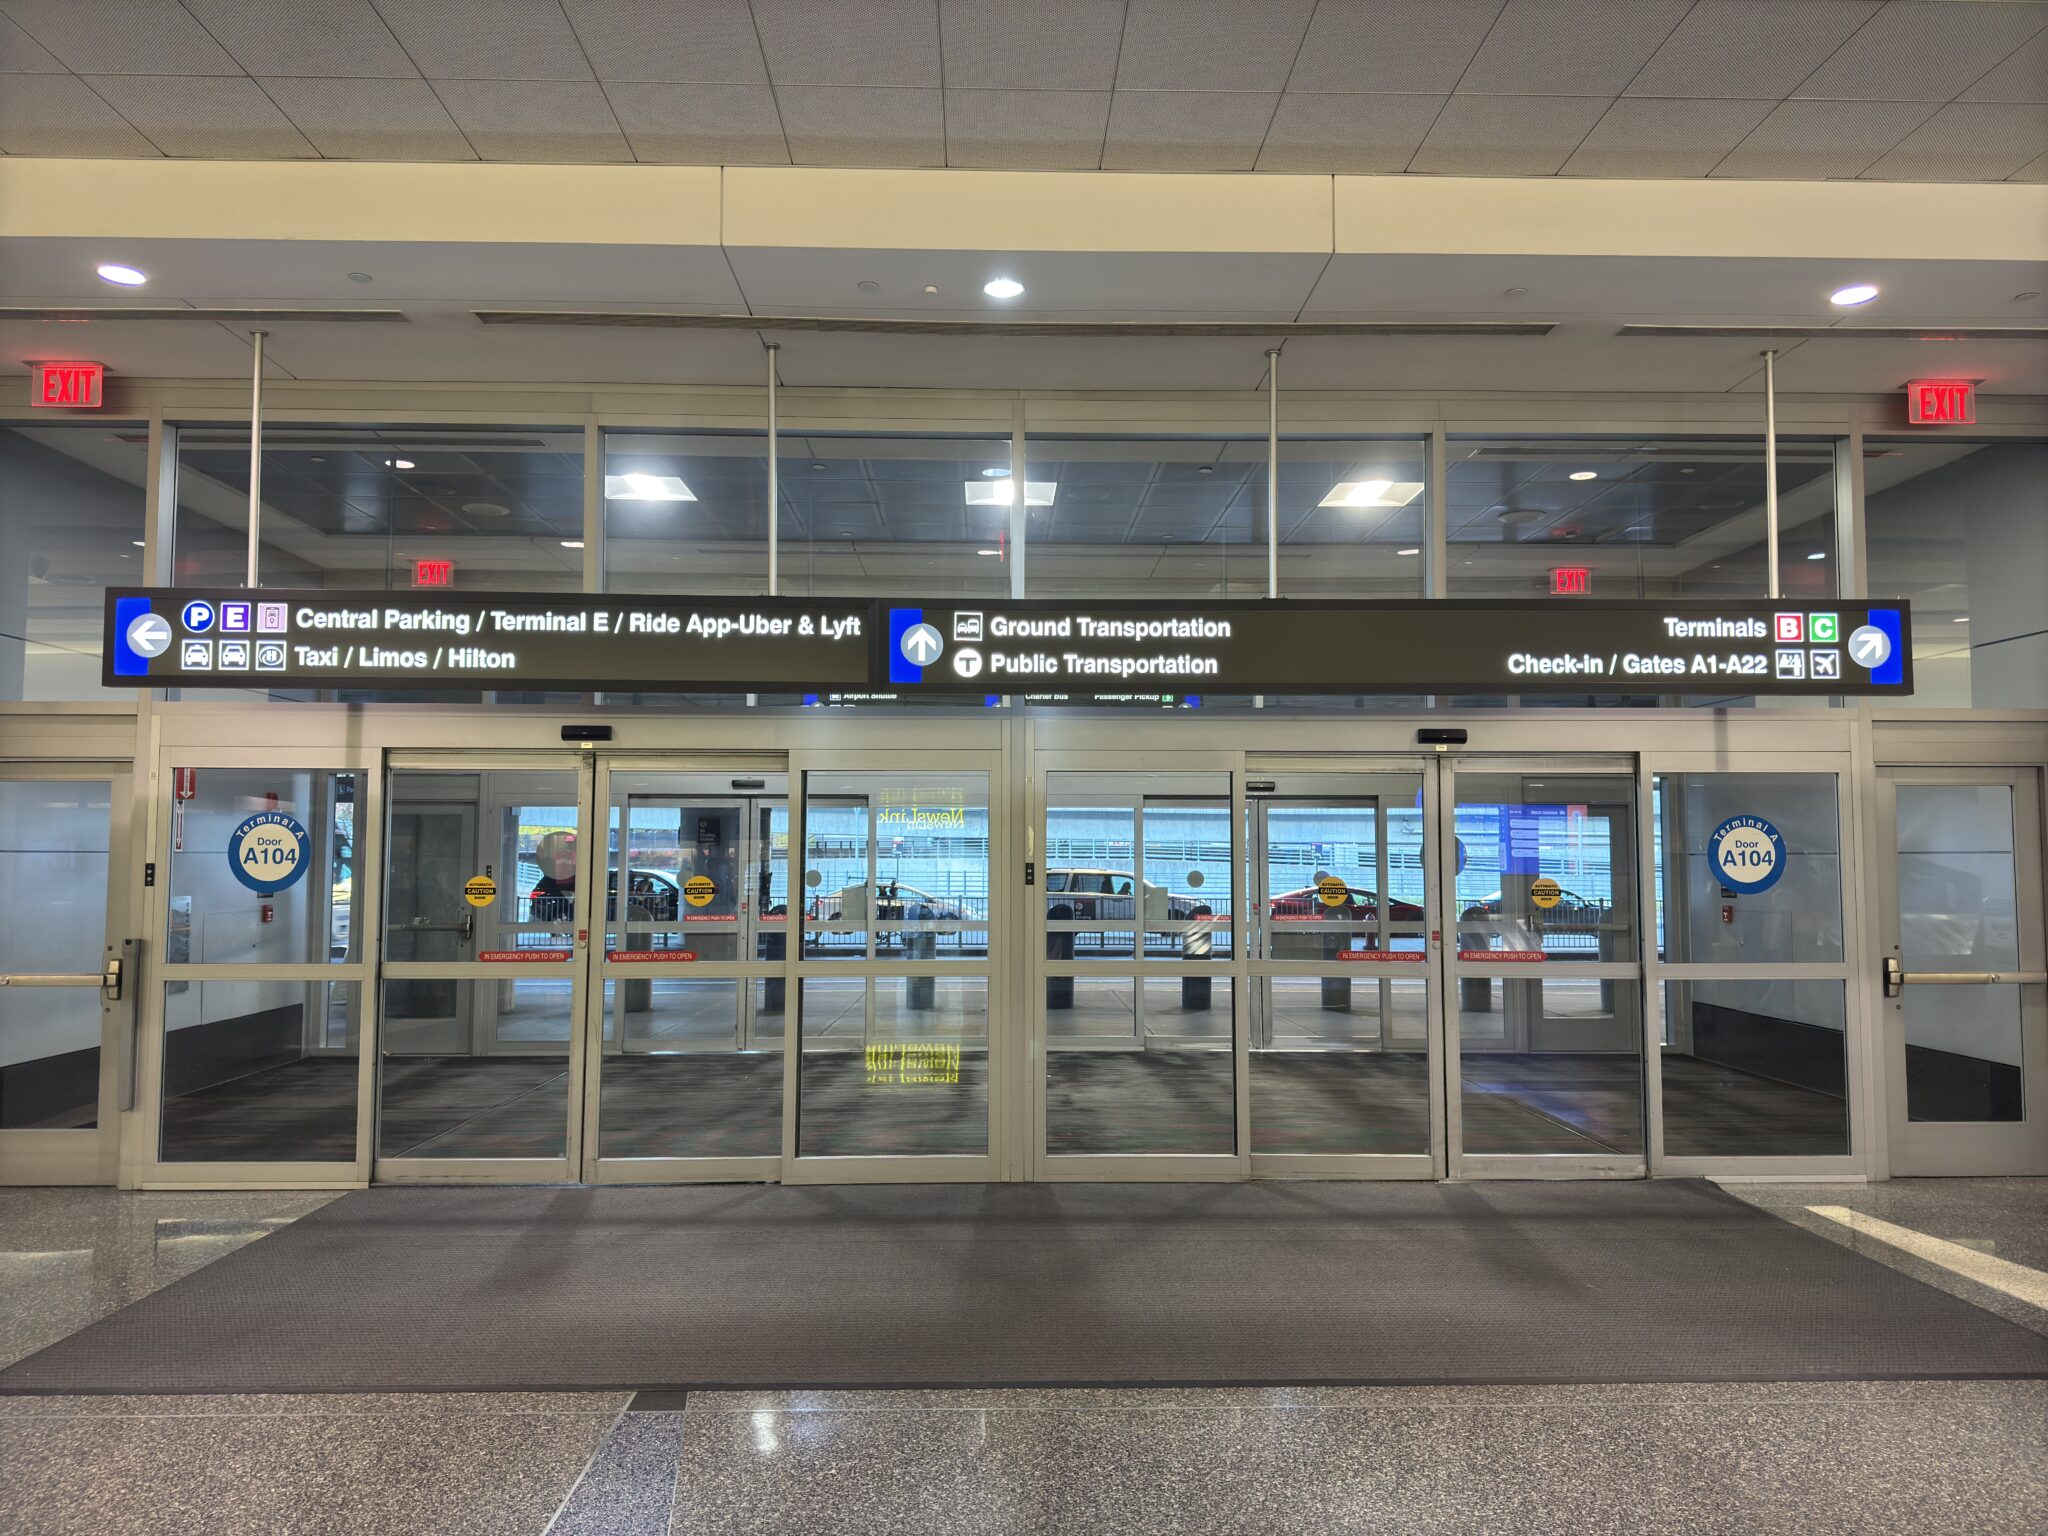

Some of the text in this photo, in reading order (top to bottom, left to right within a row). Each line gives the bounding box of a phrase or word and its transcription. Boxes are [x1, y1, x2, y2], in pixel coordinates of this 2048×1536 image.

[43, 368, 96, 403] EXIT
[1920, 387, 1969, 421] EXIT
[418, 563, 449, 584] EXIT
[1556, 571, 1587, 592] EXIT
[190, 606, 861, 640] P E Central Parking / Terminal E / Ride App-Uber & Lyft
[991, 616, 1231, 642] Ground Transportation
[1664, 617, 1834, 639] Terminals B C
[294, 646, 338, 667] Taxi
[343, 646, 354, 669] /
[359, 647, 429, 669] Limos
[432, 647, 443, 670] /
[448, 648, 516, 669] Hilton
[991, 653, 1058, 674] Public
[1063, 654, 1218, 678] Transportation
[1507, 653, 1768, 676] Check-in / Gates A1-A22
[236, 813, 304, 840] Terminal A
[1713, 817, 1778, 843] Terminal A
[257, 837, 282, 846] Door
[1735, 840, 1759, 849] Door
[243, 847, 297, 865] A104
[1722, 849, 1774, 867] A104
